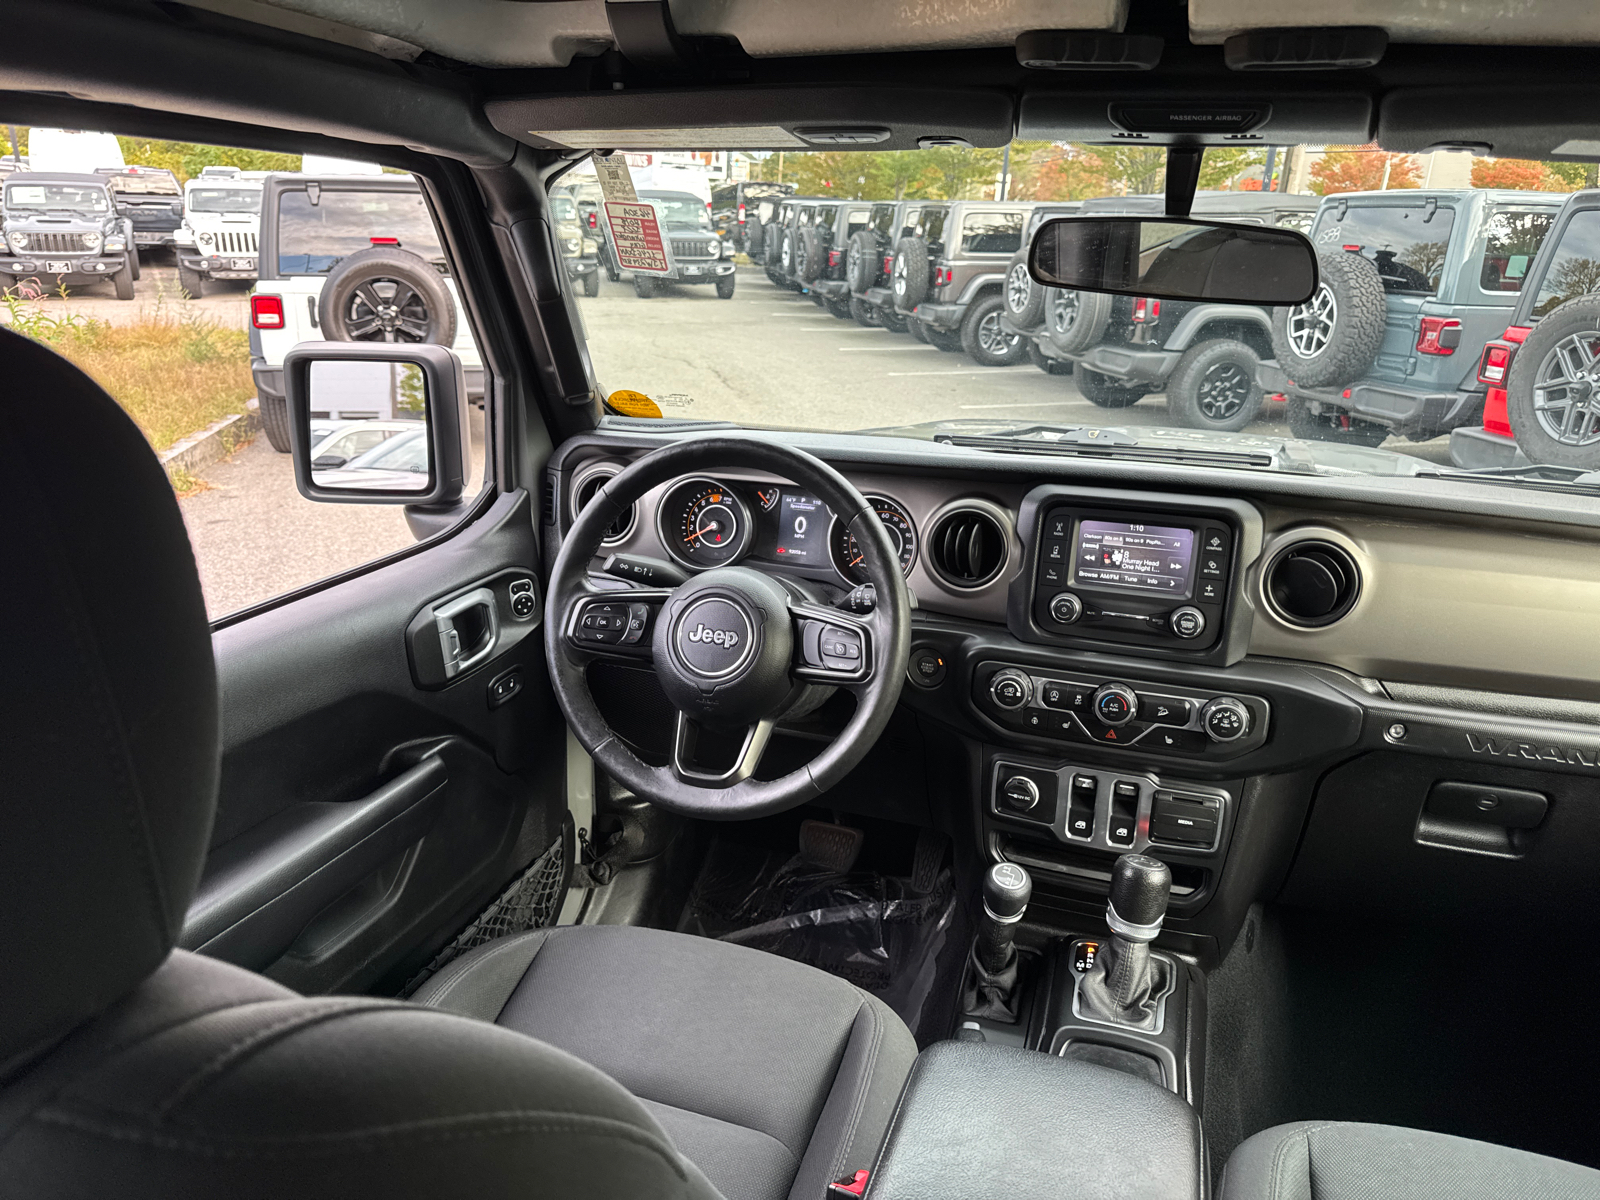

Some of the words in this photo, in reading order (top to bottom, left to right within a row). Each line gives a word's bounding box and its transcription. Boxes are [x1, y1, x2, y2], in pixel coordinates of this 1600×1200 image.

[794, 516, 806, 533] 0
[1130, 524, 1144, 532] 1:10
[1123, 558, 1143, 566] Murray
[1079, 570, 1098, 578] Browse
[689, 624, 739, 648] Jeep
[1465, 733, 1600, 766] WRAN
